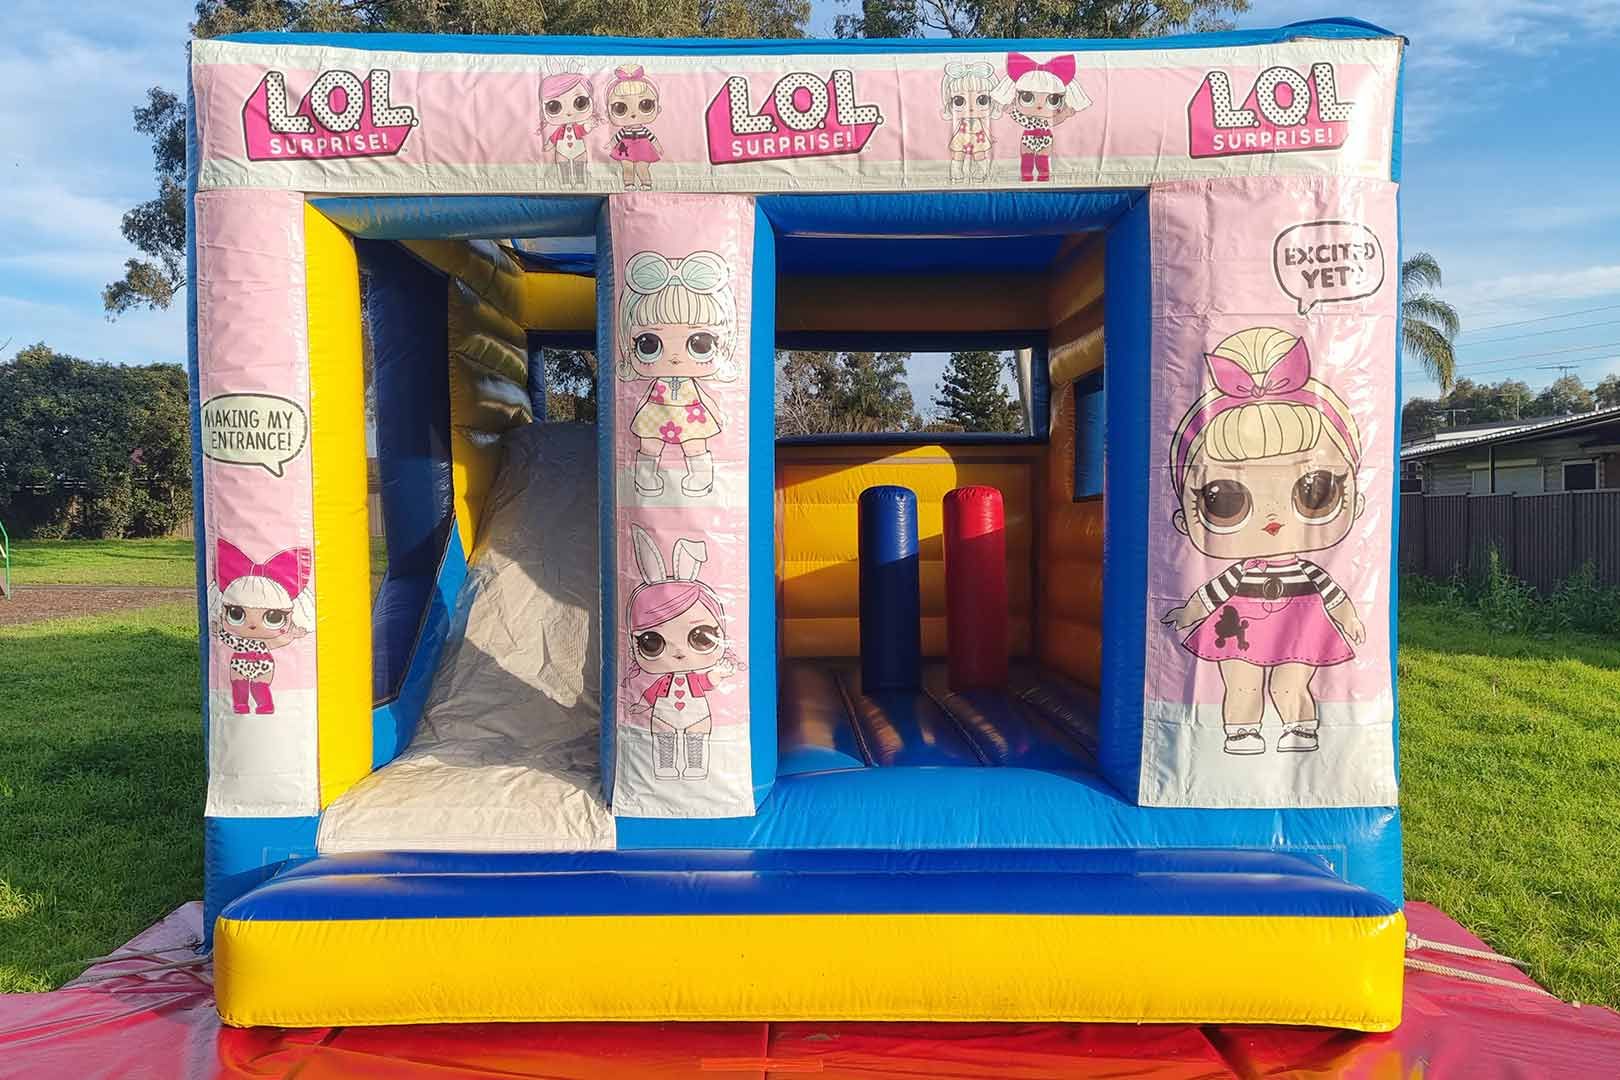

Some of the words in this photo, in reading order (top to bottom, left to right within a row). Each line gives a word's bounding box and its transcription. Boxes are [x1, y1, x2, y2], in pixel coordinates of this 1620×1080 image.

[269, 132, 388, 155] SURPRISE!
[731, 131, 853, 158] SURPRISE!
[1212, 127, 1333, 151] SURPRISE!
[204, 409, 260, 429] MAKING
[267, 410, 293, 429] MY
[211, 431, 292, 452] ENTRANCE!
